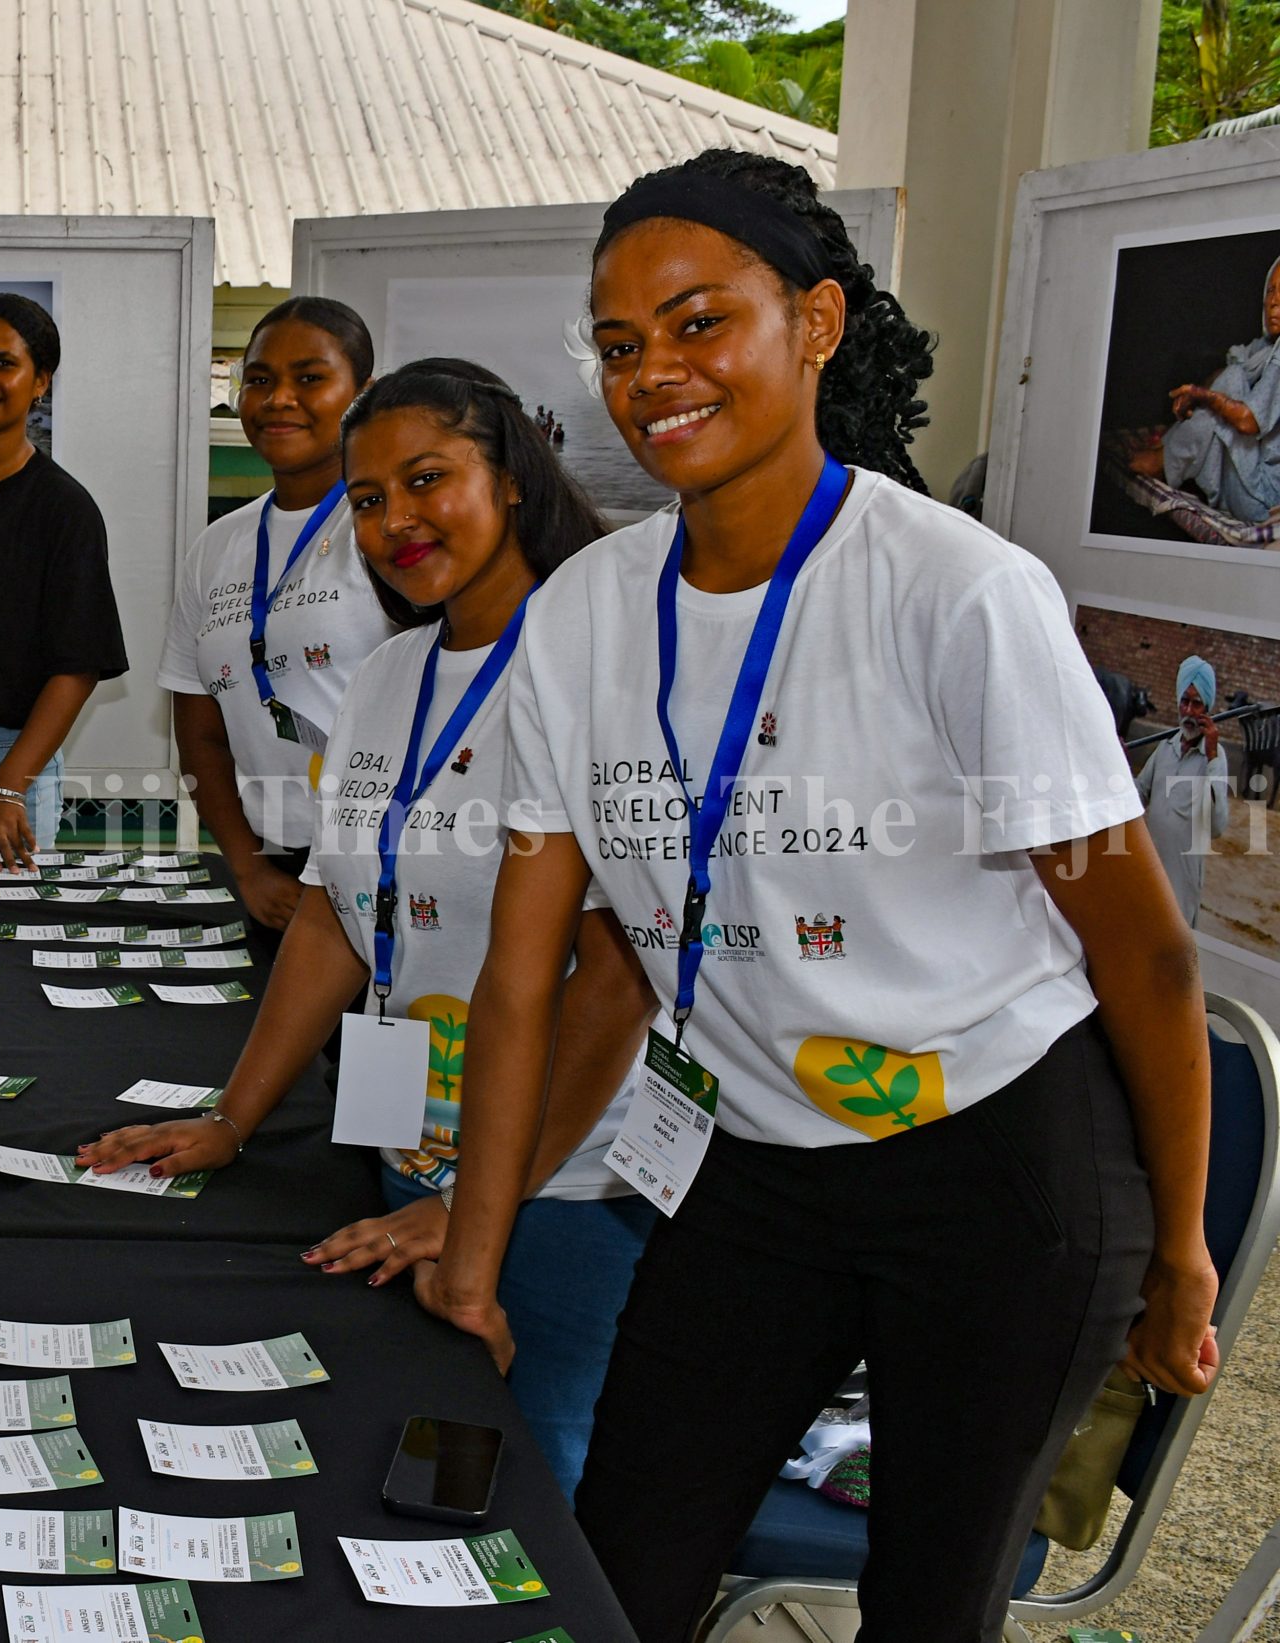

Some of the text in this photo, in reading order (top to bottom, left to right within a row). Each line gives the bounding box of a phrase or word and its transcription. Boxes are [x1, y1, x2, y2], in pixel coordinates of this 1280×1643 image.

[209, 581, 256, 600] GLOBA
[297, 589, 340, 606] 2024
[347, 751, 392, 773] OBAL
[591, 758, 693, 786] GLOBAL
[592, 789, 783, 823] DEVELOPENT
[409, 810, 457, 832] 2024
[781, 826, 868, 854] 2024
[721, 924, 761, 948] USP
[646, 1075, 694, 1116] GLOBAL SYNERGIES
[652, 1122, 675, 1144] RAVELA
[657, 1112, 679, 1134] KALESI
